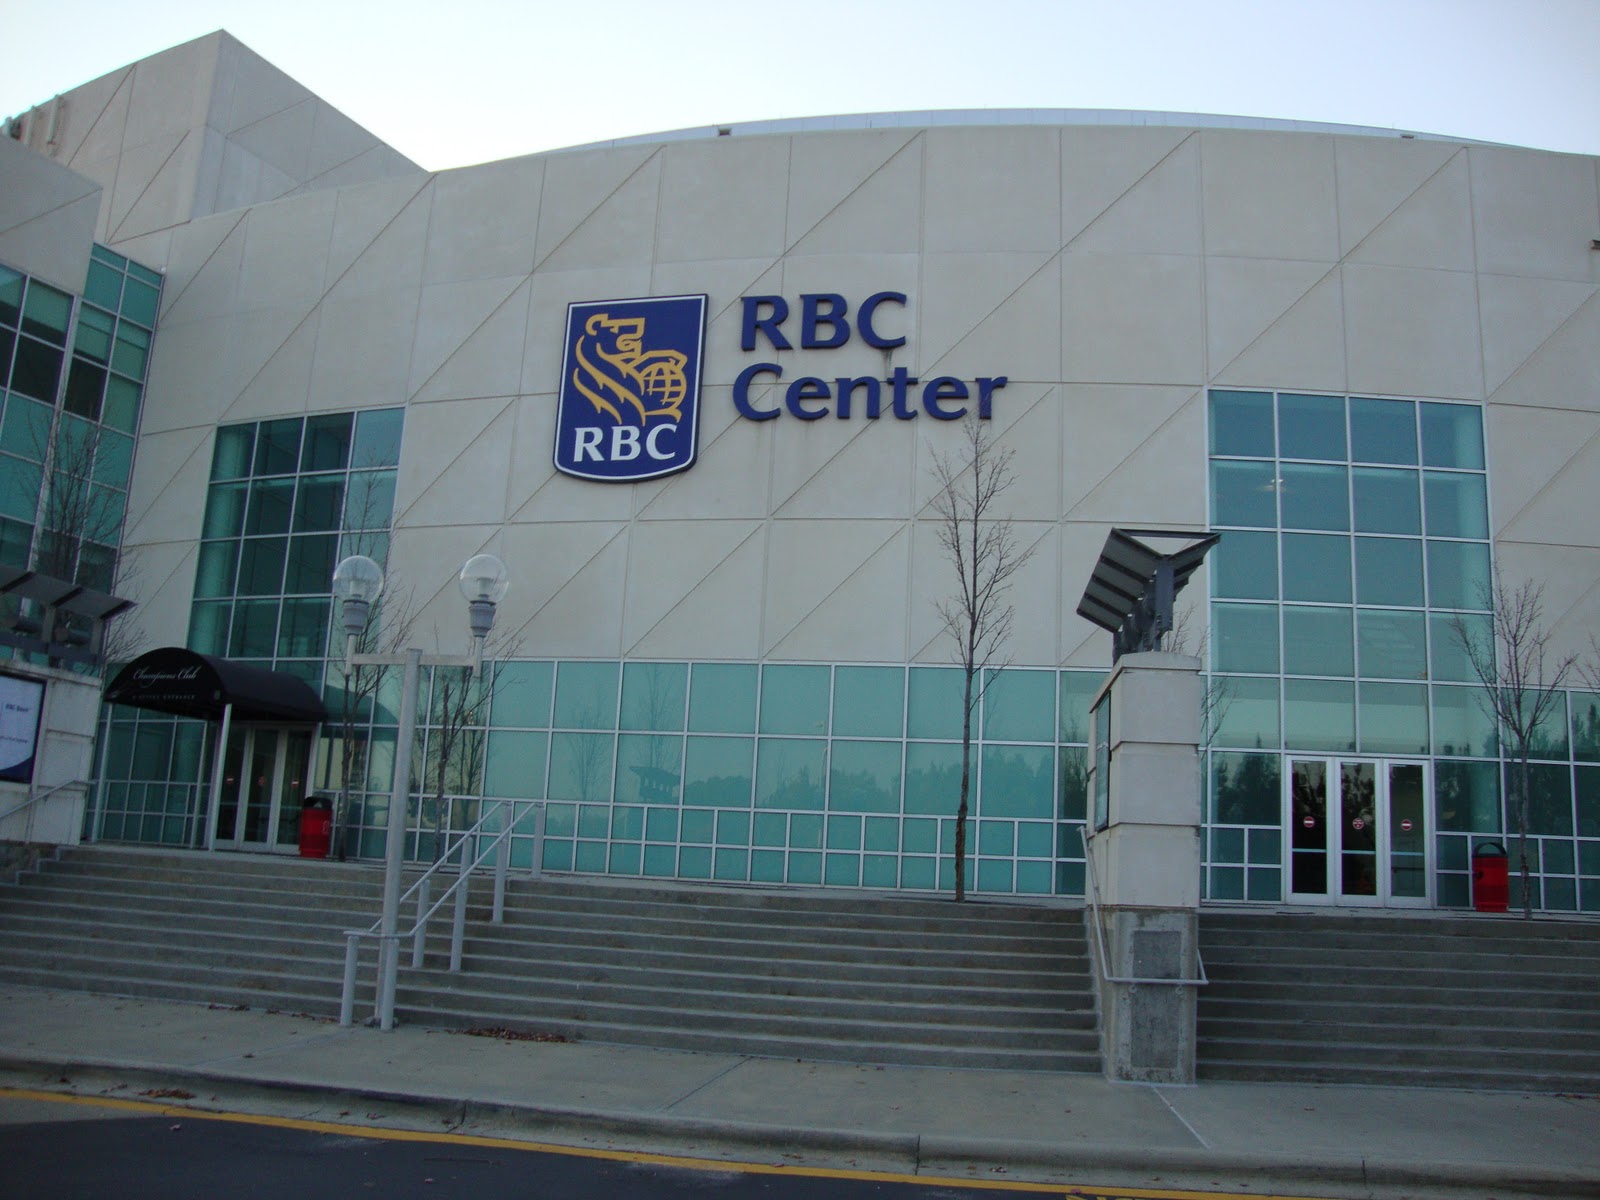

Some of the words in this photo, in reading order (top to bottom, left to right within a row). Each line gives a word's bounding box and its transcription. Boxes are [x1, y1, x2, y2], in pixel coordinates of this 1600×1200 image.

[740, 291, 908, 351] RBC
[732, 362, 1008, 421] Center
[573, 423, 678, 463] RBC
[132, 665, 176, 688] Champions
[177, 665, 203, 680] Club
